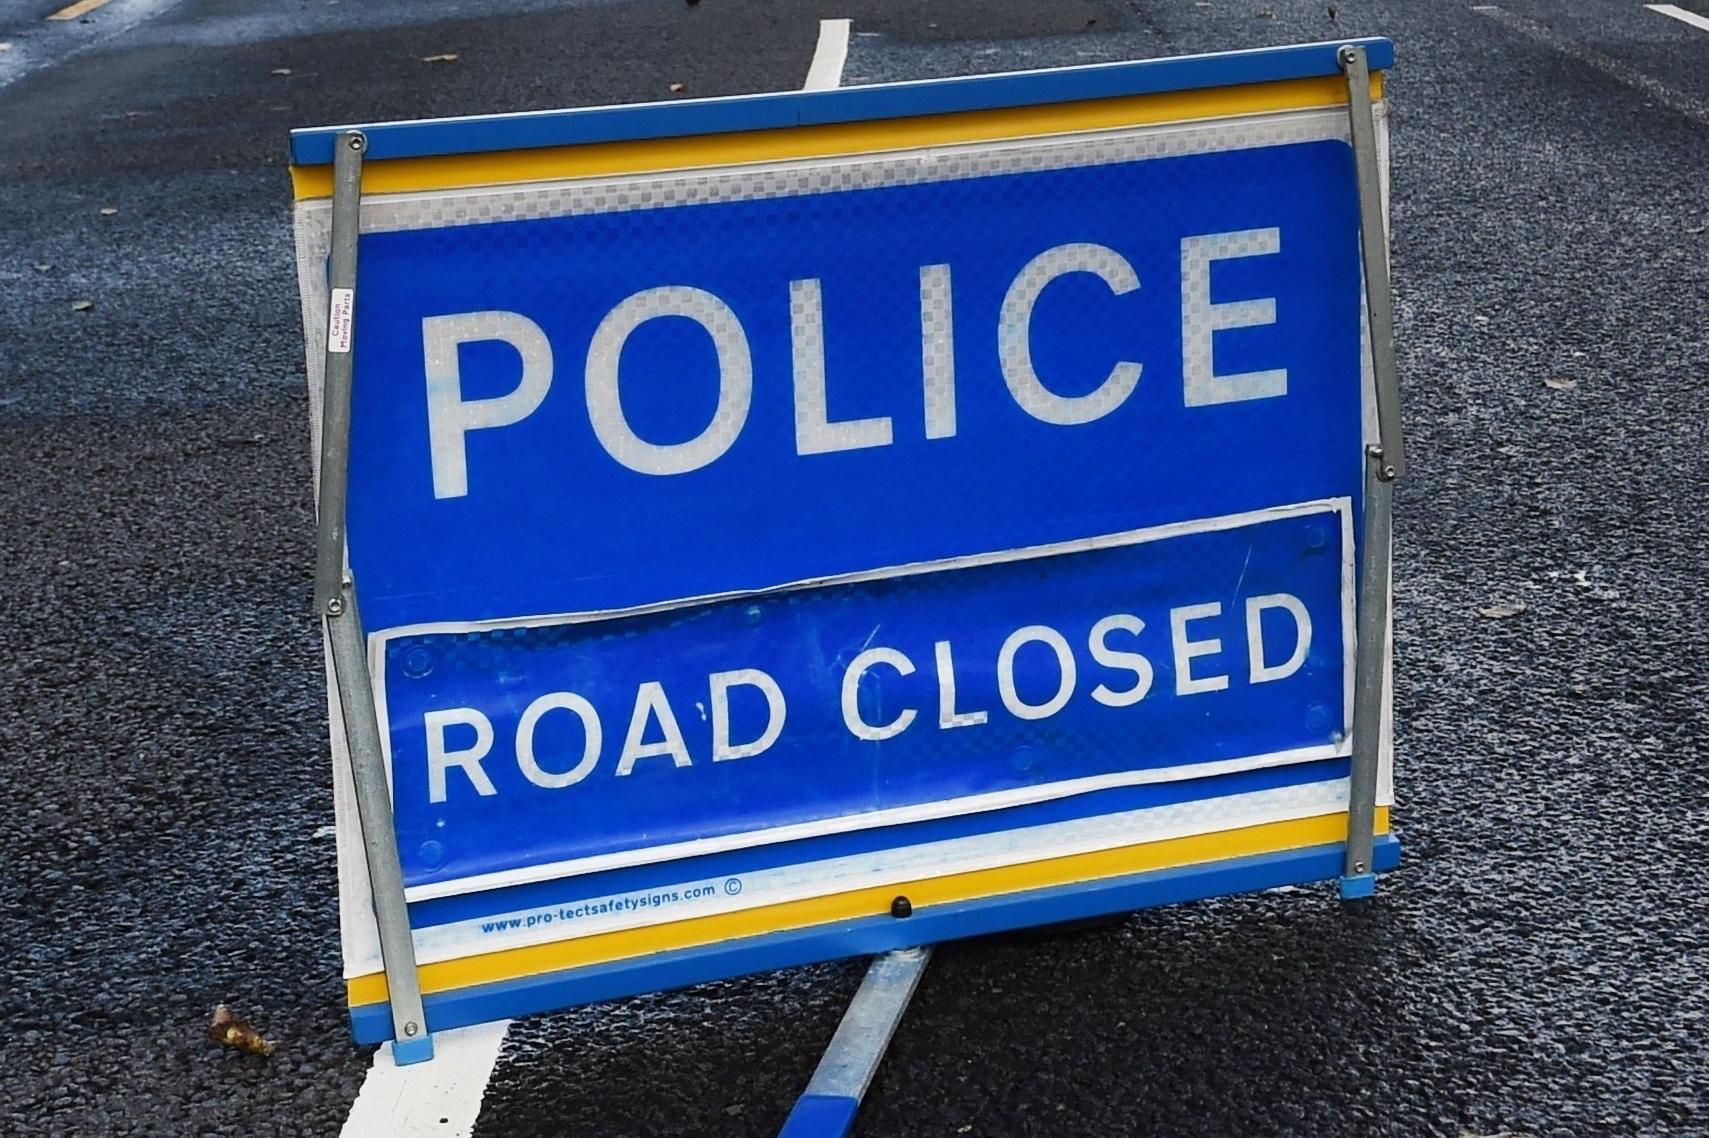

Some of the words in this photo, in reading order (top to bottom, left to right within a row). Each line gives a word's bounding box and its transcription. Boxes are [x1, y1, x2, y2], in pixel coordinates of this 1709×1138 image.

[332, 304, 341, 336] Caution
[342, 293, 351, 315] Parts
[340, 319, 350, 348] Moving
[421, 227, 1288, 499] POLICE
[424, 669, 786, 804] ROAD
[842, 592, 1313, 742] CLOSED
[481, 884, 716, 934] www.pro-tectsafetysigns.com
